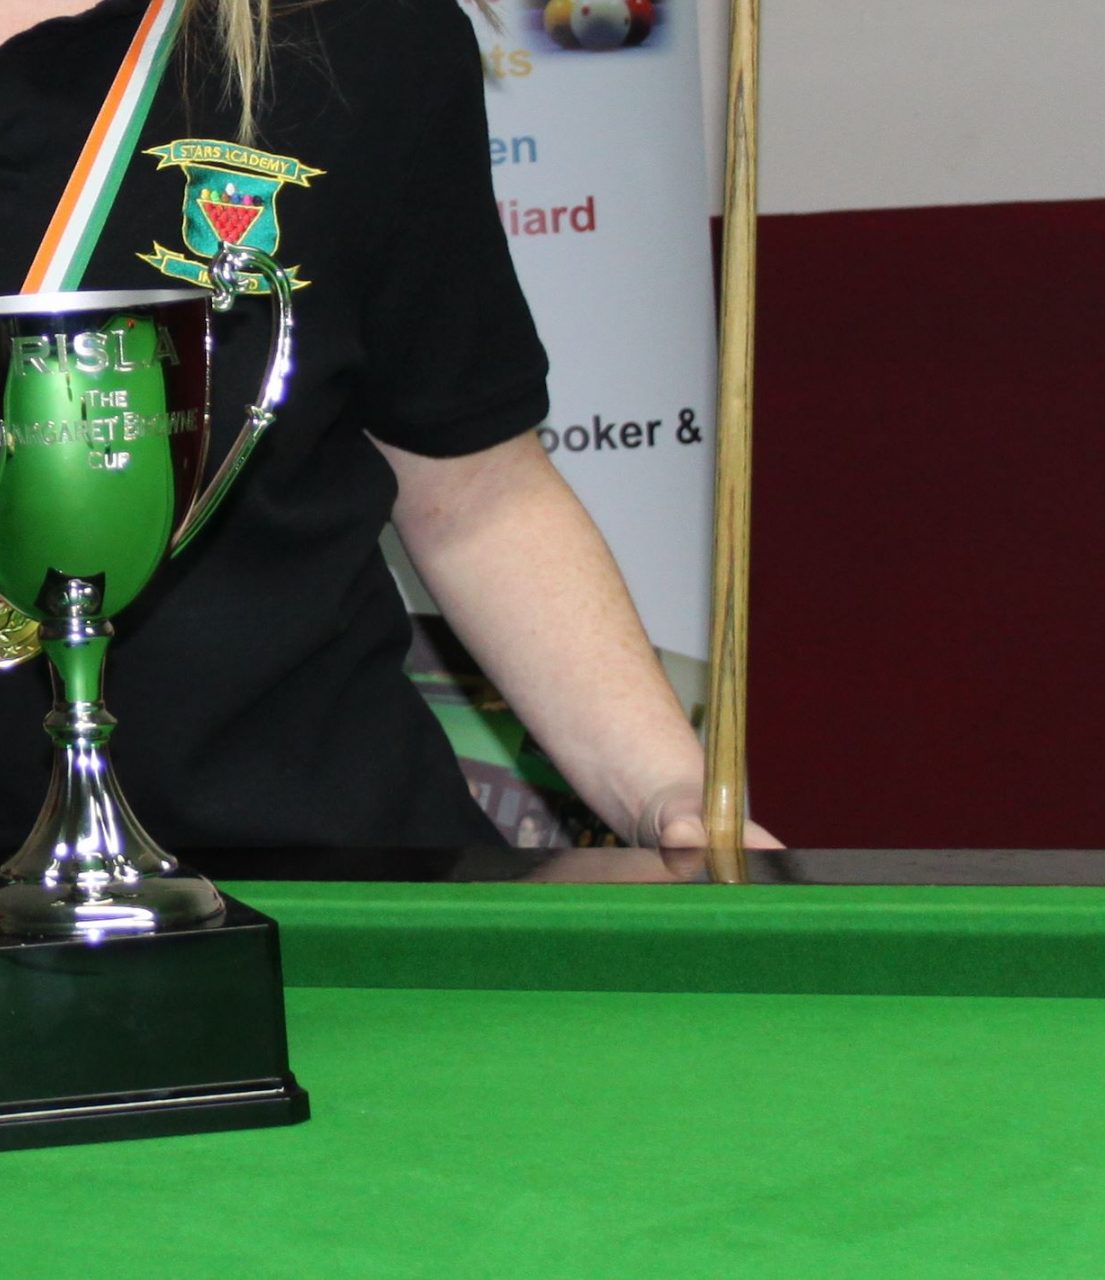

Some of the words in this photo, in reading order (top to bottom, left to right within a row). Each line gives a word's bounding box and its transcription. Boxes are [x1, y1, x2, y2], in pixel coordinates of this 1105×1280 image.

[180, 146, 222, 158] STARS
[12, 325, 180, 376] RISLA
[87, 390, 128, 408] THE
[676, 408, 702, 445] &
[88, 451, 131, 469] CUP
